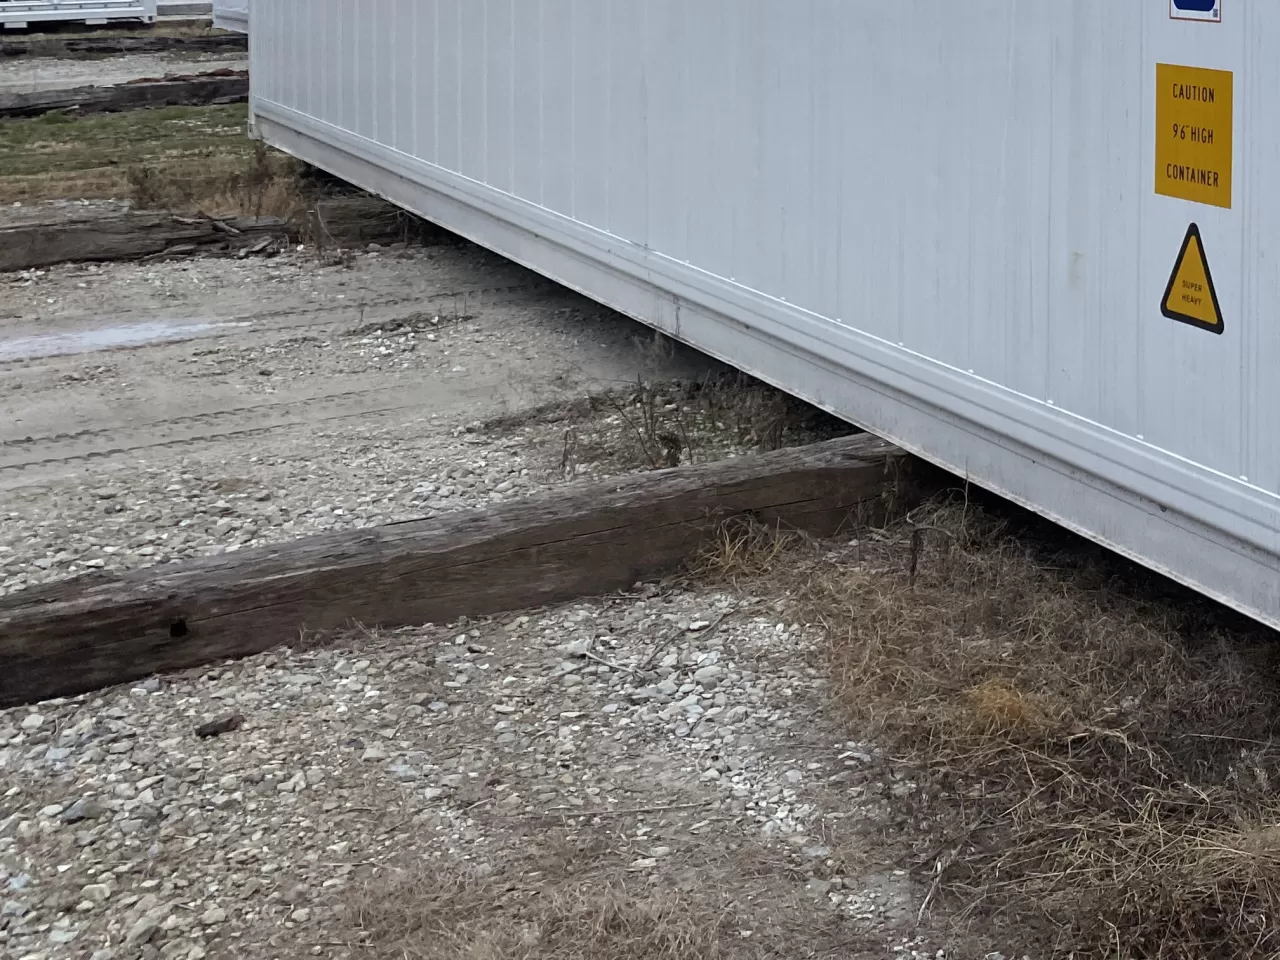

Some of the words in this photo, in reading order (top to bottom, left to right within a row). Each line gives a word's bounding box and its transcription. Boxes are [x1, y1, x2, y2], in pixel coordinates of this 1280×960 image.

[1172, 83, 1215, 103] CAUTION
[1190, 126, 1214, 144] HIGH
[1166, 163, 1219, 188] CONTAINER
[1182, 280, 1203, 292] SUPER
[1181, 293, 1202, 306] HEAVY
